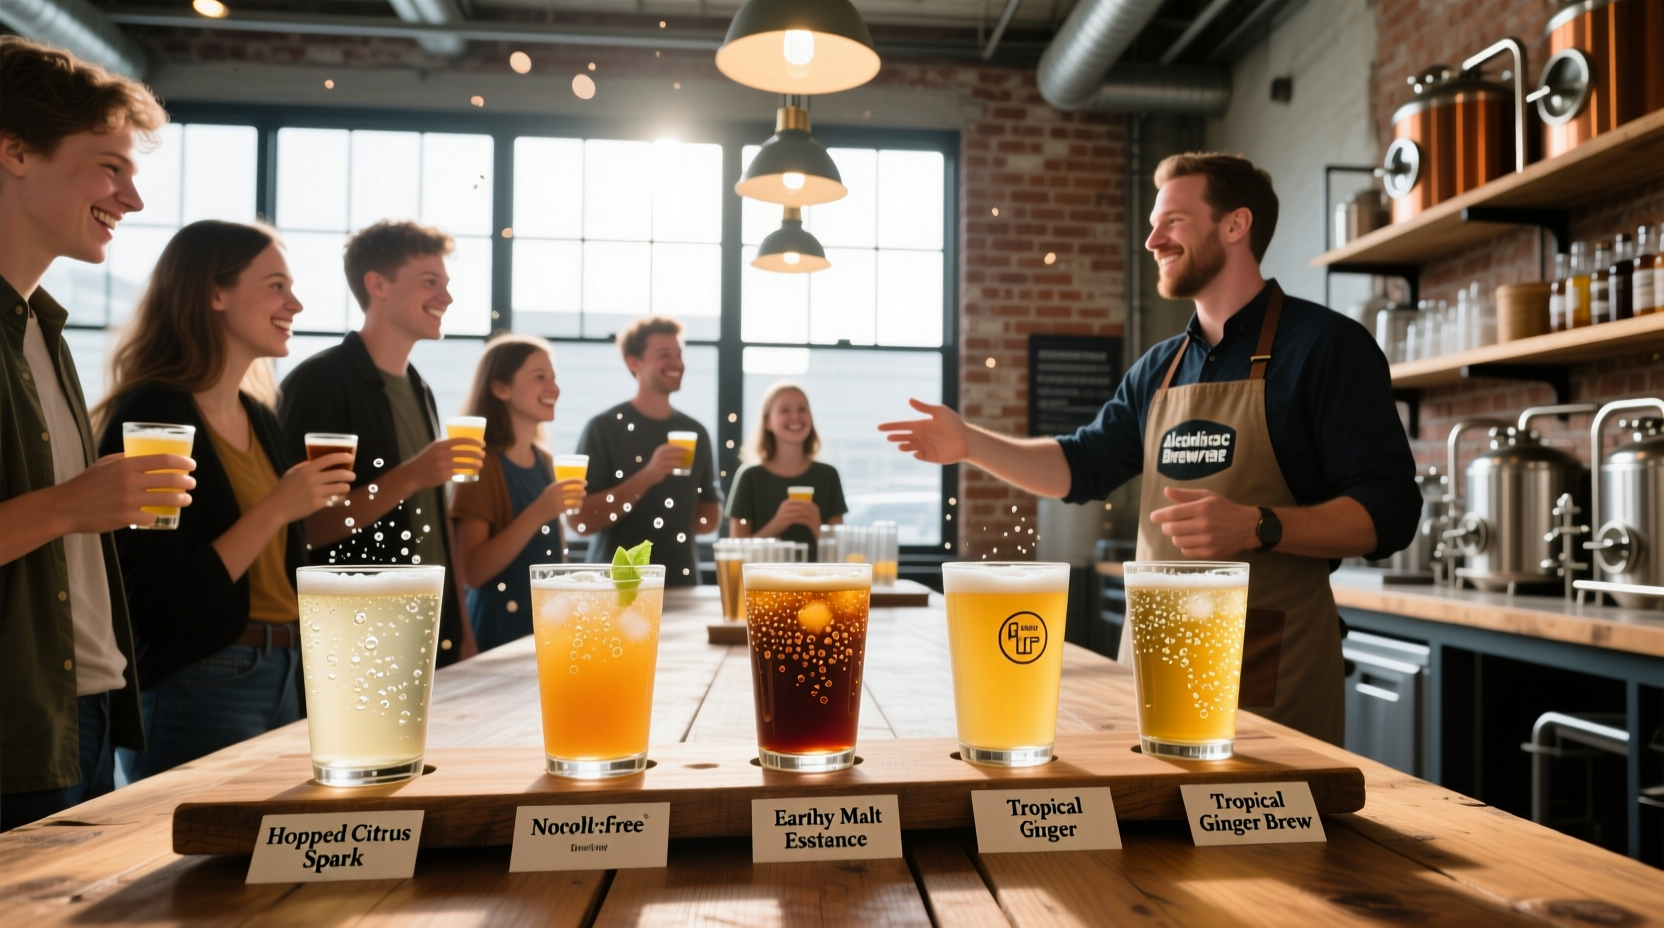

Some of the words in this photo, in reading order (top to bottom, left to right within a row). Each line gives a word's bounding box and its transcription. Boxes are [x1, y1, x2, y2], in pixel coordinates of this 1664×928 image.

[1006, 796, 1083, 820] Tropical
[1210, 790, 1286, 813] Tropical
[840, 806, 882, 824] Malt
[1200, 814, 1261, 836] Ginger
[1263, 813, 1312, 830] Brew
[266, 824, 347, 850] Hopped
[351, 824, 411, 842] Citrus
[785, 832, 867, 849] Esstance
[303, 847, 364, 873] Spark
